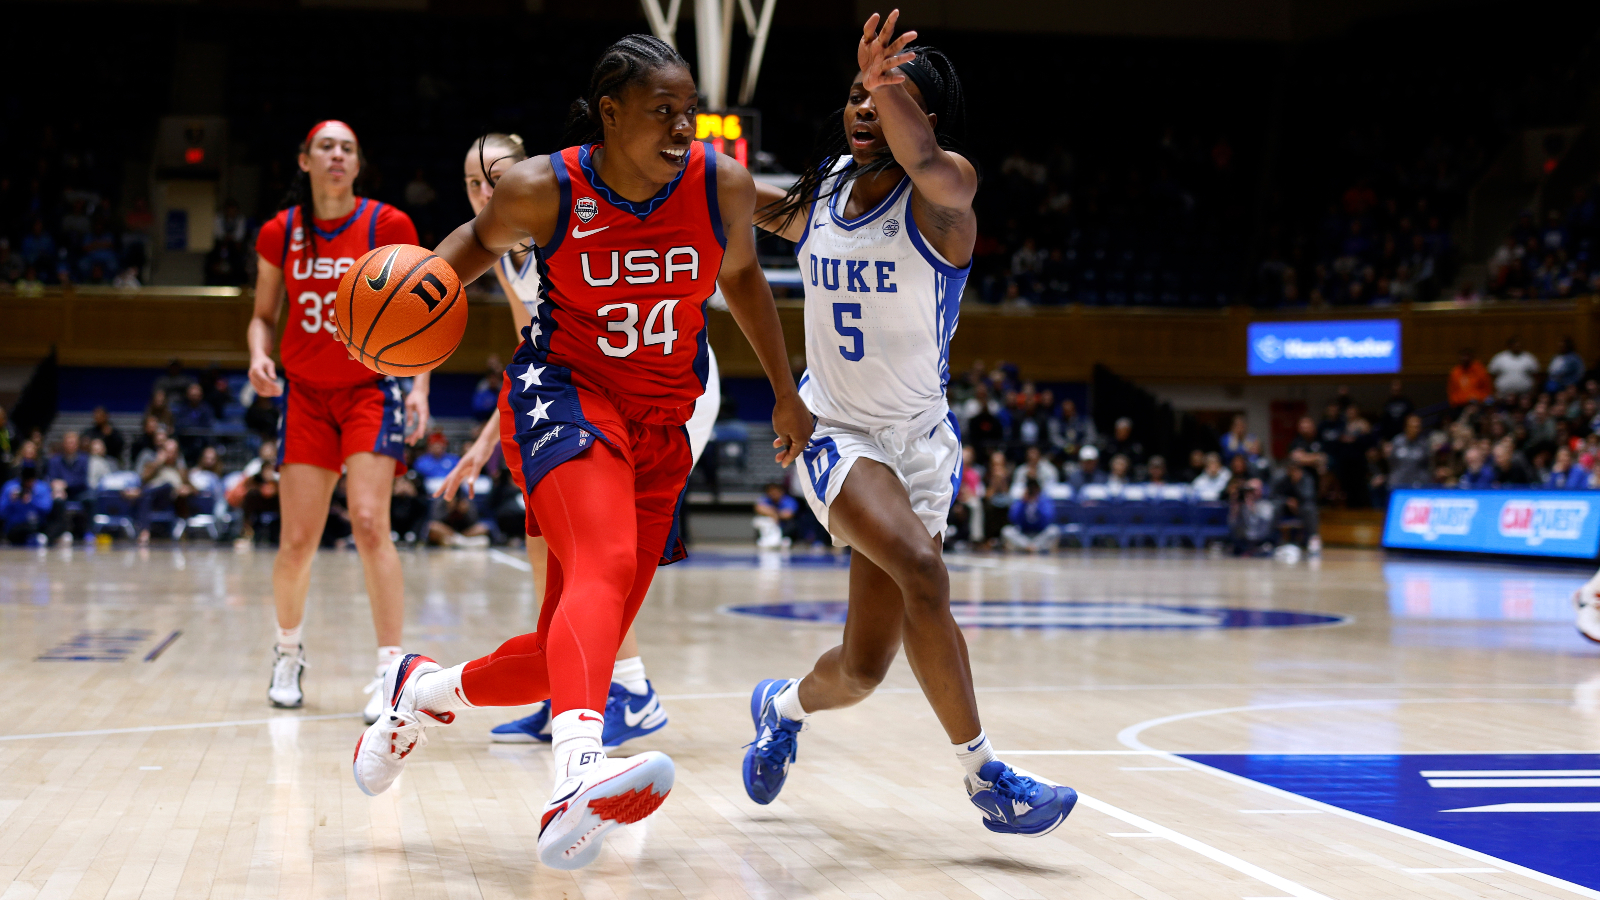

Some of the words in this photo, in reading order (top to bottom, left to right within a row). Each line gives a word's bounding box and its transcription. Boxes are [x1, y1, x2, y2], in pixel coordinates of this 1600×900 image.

[580, 246, 699, 287] USA
[810, 253, 898, 293] DUKE
[596, 299, 681, 358] 34
[832, 302, 865, 362] 5
[531, 425, 564, 457] USA
